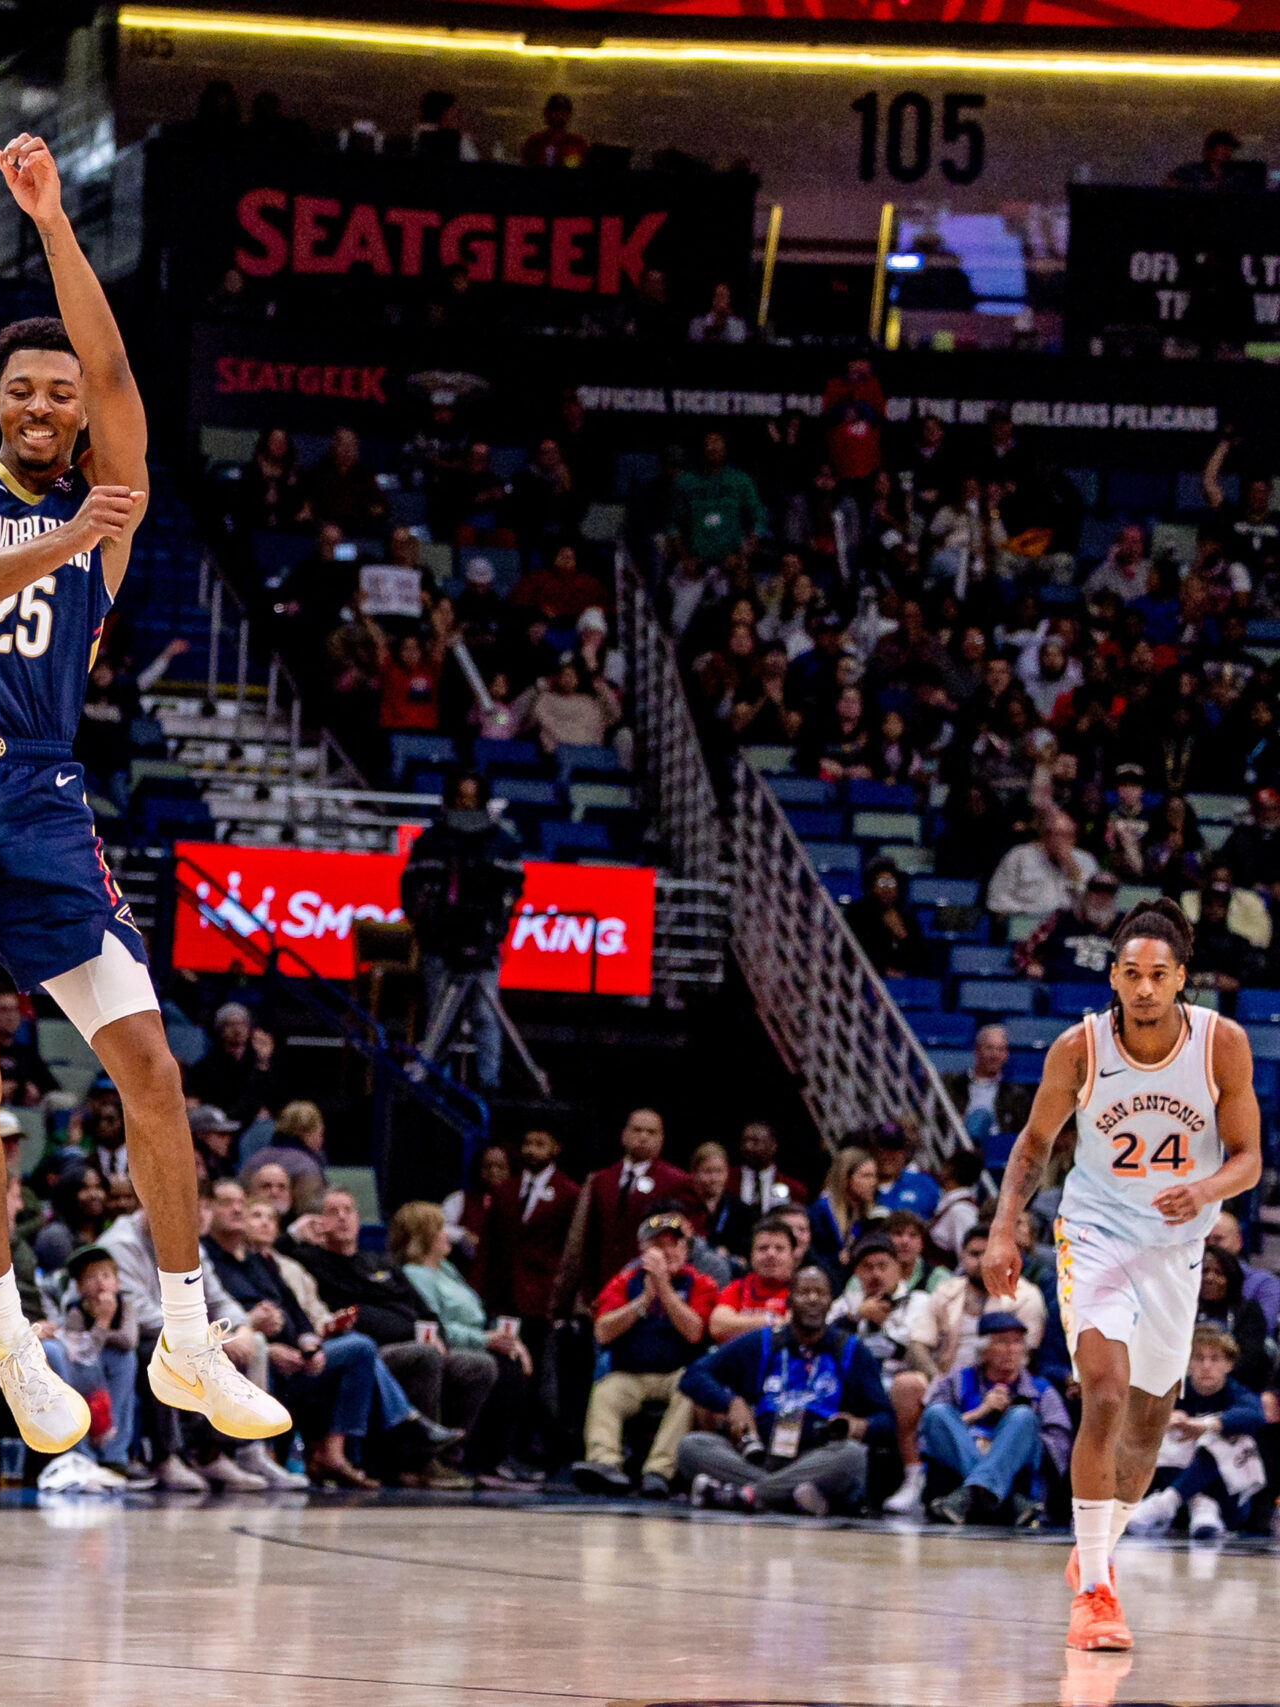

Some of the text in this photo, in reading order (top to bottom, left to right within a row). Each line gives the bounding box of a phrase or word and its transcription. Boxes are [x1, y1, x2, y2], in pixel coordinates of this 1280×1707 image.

[851, 91, 986, 184] 105
[235, 188, 668, 295] SEATGEEK
[216, 356, 387, 403] SEATGEEK
[577, 384, 667, 413] OFFICIAL
[672, 388, 783, 416] TICKETING
[885, 397, 911, 422] OF
[960, 400, 1000, 424] NE
[1011, 401, 1110, 428] ORLEANS
[1113, 404, 1218, 432] PELICANS
[1095, 1094, 1206, 1135] SAN ANTONIO
[1111, 1130, 1195, 1178] 24
